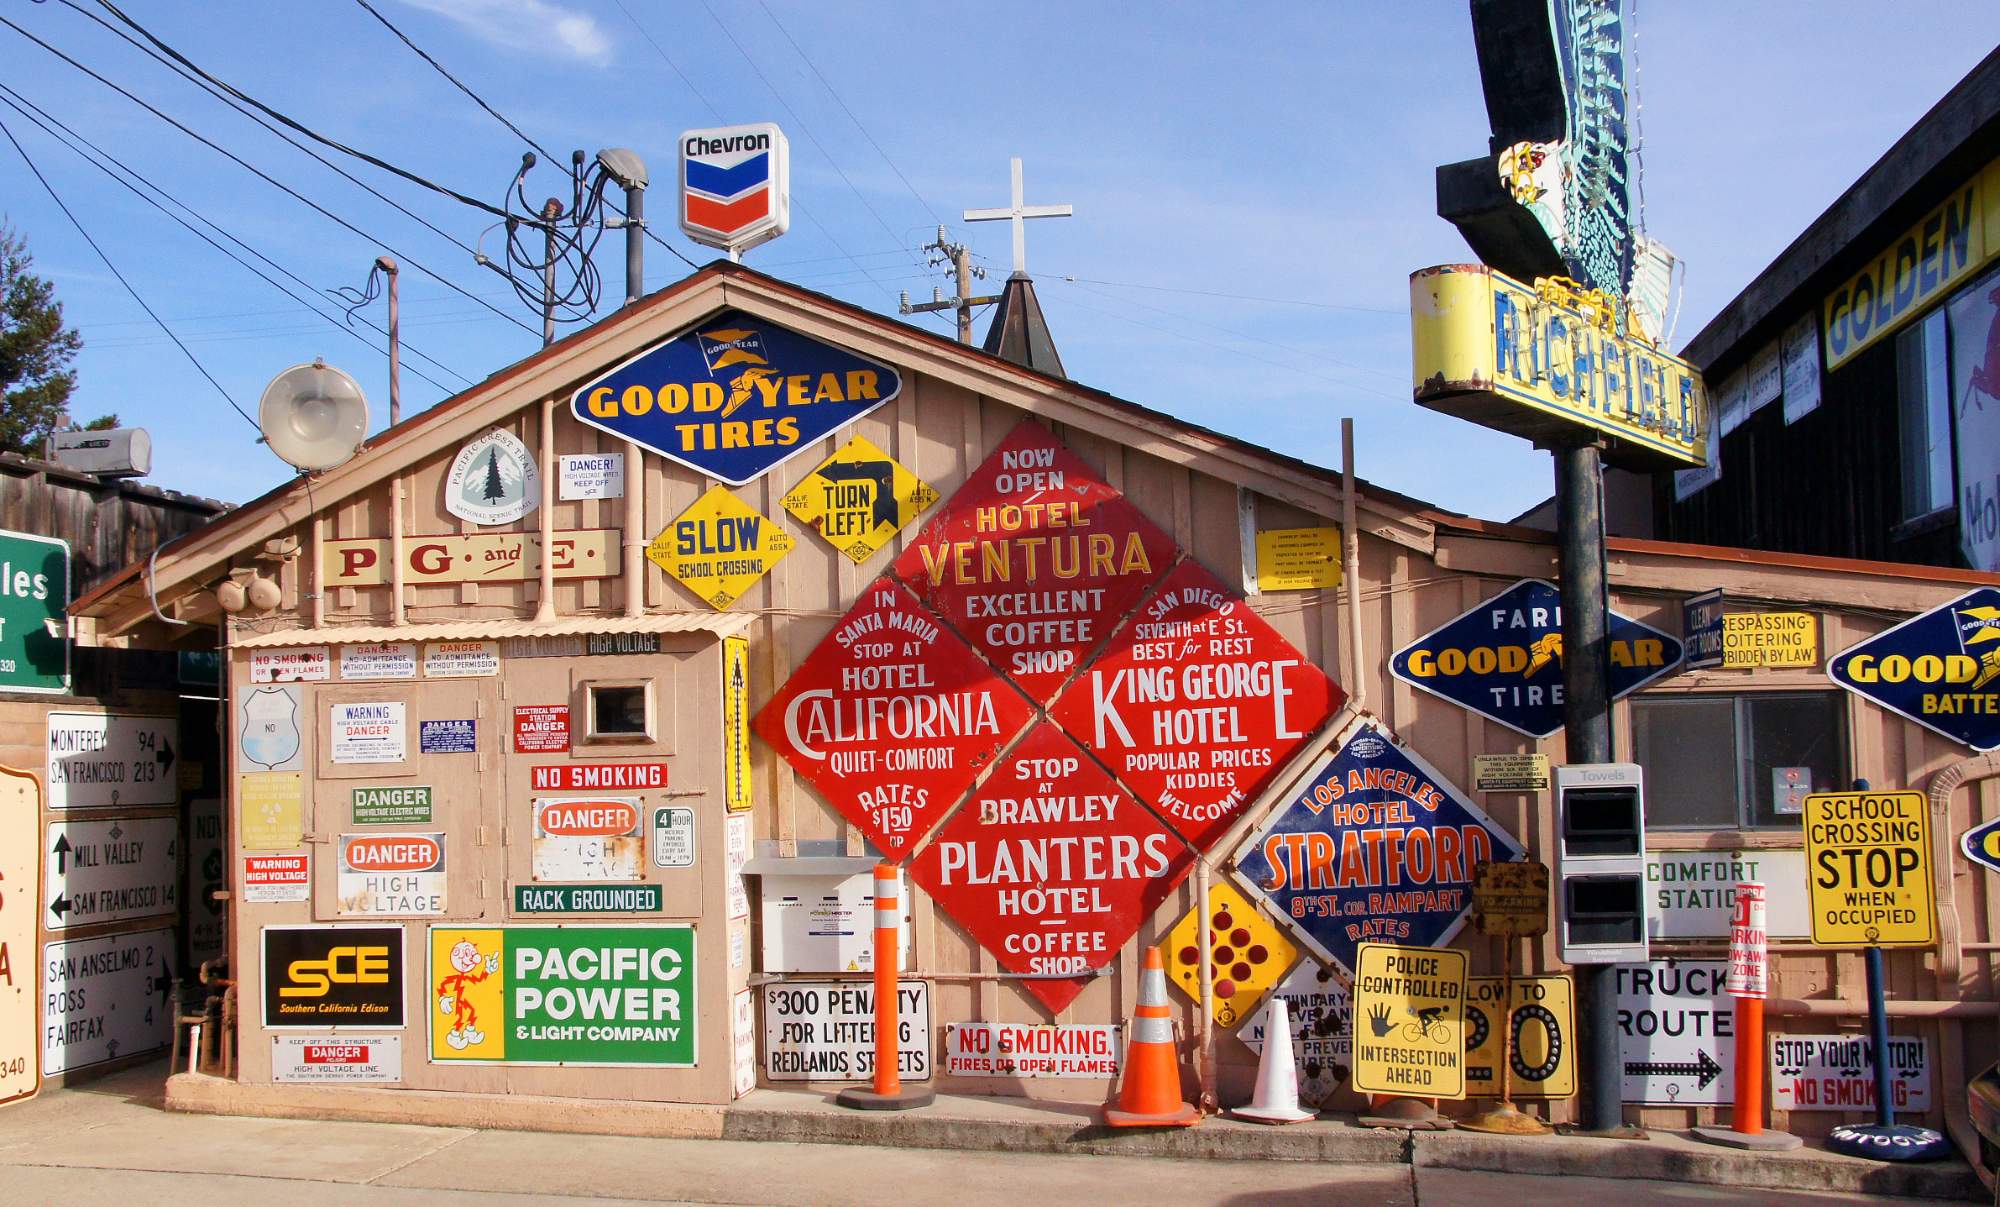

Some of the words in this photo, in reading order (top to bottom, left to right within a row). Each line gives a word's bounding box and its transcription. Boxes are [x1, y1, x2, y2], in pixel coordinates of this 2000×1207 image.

[686, 134, 769, 156] Chevron
[1831, 187, 1973, 356] GOLDEN
[675, 417, 800, 451] TIRES
[453, 443, 478, 485] PACIFIC
[480, 431, 514, 449] CREST
[514, 446, 534, 481] TRAIL
[570, 459, 613, 471] DANGER!
[1003, 448, 1055, 470] NOW
[574, 480, 592, 488] KEEP
[595, 479, 609, 487] OFF
[996, 471, 1064, 493] OPEN
[823, 484, 870, 510] TURN
[455, 503, 487, 518] NATIONAL
[977, 502, 1090, 532] HOTEL
[825, 511, 868, 536] LEFT
[677, 516, 761, 555] SLOW
[769, 534, 788, 542] AUTO
[484, 543, 522, 562] and
[653, 551, 672, 559] STATE
[920, 532, 1152, 586] VENTURA
[678, 561, 714, 578] SCHOOL
[716, 559, 763, 577] CROSSING
[875, 591, 895, 607] IN
[966, 589, 1105, 617] EXCELLENT
[1147, 592, 1180, 621] SAN
[1184, 588, 1234, 617] DIEGO
[836, 614, 884, 648] SANTA
[889, 611, 939, 645] MARIA
[986, 619, 1093, 646] COFFEE
[1136, 621, 1192, 639] SEVENTH
[357, 645, 399, 654] DANGER
[439, 643, 482, 652] DANGER
[590, 634, 612, 653] HIGH
[616, 633, 658, 652] VOLTAGE
[854, 642, 893, 659] STOP
[903, 641, 922, 656] AT
[1133, 642, 1175, 660] BEST
[1177, 639, 1201, 661] for
[1210, 638, 1254, 656] REST
[255, 656, 270, 665] NO
[373, 661, 414, 670] PERMISSION
[454, 660, 497, 668] PERMISSION
[1012, 649, 1074, 675] SHOP
[1770, 650, 1784, 663] BY
[1787, 648, 1812, 662] LAW
[842, 664, 934, 691] HOTEL
[1092, 666, 1175, 749] KING
[1183, 660, 1302, 739] GEORGE
[1490, 684, 1564, 707] TIRE
[346, 706, 390, 719] WARNING
[346, 726, 390, 736] DANGER
[521, 722, 565, 731] DANGER
[784, 689, 1000, 760] CALIFORNIA
[1153, 706, 1248, 746] HOTEL
[51, 730, 107, 753] MONTEREY
[1015, 758, 1079, 780] STOP
[1126, 752, 1200, 772] POPULAR
[1211, 748, 1272, 768] PRICES
[51, 762, 70, 784] SAN
[74, 761, 125, 784] FRANCISCO
[134, 761, 155, 782] 213
[537, 769, 560, 788] NO
[572, 766, 661, 787] SMOKING
[1166, 772, 1235, 790] KIDDIES
[1580, 770, 1626, 783] Towels
[355, 790, 427, 806] DANGER
[857, 784, 929, 812] RATES
[1038, 782, 1053, 794] AT
[1302, 775, 1345, 815] LOS
[1349, 767, 1445, 811] ANGELES
[979, 795, 1120, 825] BRAWLEY
[1157, 785, 1247, 821] WELCOME
[1333, 801, 1415, 826] HOTEL
[1821, 799, 1909, 820] SCHOOL
[547, 809, 630, 829] DANGER
[659, 812, 669, 826] 4
[672, 815, 691, 826] HOUR
[1812, 822, 1920, 844] CROSSING
[75, 845, 99, 868] MILL
[104, 841, 143, 865] VALLEY
[253, 860, 301, 869] WARNING
[353, 844, 432, 864] DANGER
[939, 833, 1169, 886] PLANTERS
[1263, 824, 1492, 892] STRATFORD
[246, 872, 267, 881] HIGH
[268, 871, 307, 881] VOLTAGE
[1647, 861, 1760, 882] COMFORT
[1817, 848, 1919, 889] STOP
[367, 877, 418, 892] HIGH
[74, 893, 97, 916] SAN
[99, 887, 156, 912] FRANCISCO
[161, 884, 175, 906] 14
[522, 890, 564, 911] RACK
[572, 889, 656, 911] GROUNDED
[998, 887, 1112, 916] HOTEL
[1369, 889, 1463, 915] RAMPART
[1658, 888, 1737, 909] STATIO
[1844, 892, 1896, 906] WHEN
[1827, 909, 1916, 925] OCCUPIED
[1345, 918, 1410, 942] RATES
[1731, 929, 1766, 945] ARKIN
[1004, 931, 1107, 953] COFFEE
[49, 957, 76, 983] SAN
[80, 949, 140, 979] ANSELMO
[279, 946, 389, 997] SCE
[515, 947, 683, 983] PACIFIC
[1029, 956, 1087, 975] SHOP
[1386, 956, 1438, 977] POLICE
[1733, 964, 1761, 977] ZONE
[1364, 976, 1459, 999] CONTROLLED
[1520, 984, 1545, 1001] TO
[1616, 968, 1728, 997] TRUCK
[49, 988, 86, 1017] ROSS
[279, 1003, 317, 1014] Southern
[319, 1003, 358, 1014] California
[361, 1003, 389, 1014] Edison
[515, 988, 681, 1022] POWER
[769, 990, 819, 1016] $300
[828, 989, 922, 1016] PENTY
[47, 1015, 105, 1050] FAIRFAX
[516, 1025, 529, 1040] &
[531, 1026, 585, 1042] LIGHT
[587, 1026, 681, 1042] COMPANY
[783, 1022, 815, 1044] FOR
[1617, 1010, 1734, 1038] ROUTE
[311, 1046, 361, 1058] DANGER
[960, 1028, 990, 1054] NO
[772, 1051, 849, 1073] REDLANDS
[1361, 1045, 1457, 1068] INTERSECTION
[1775, 1041, 1814, 1068] STOP
[1819, 1040, 1860, 1069] YOUR
[1863, 1041, 1924, 1069] MTOR!
[359, 1065, 380, 1073] LINE
[951, 1058, 991, 1071] FIRES
[1020, 1059, 1057, 1072] OPEN
[1061, 1060, 1119, 1074] FLAMES
[1386, 1067, 1432, 1086] AHEAD
[1794, 1079, 1818, 1106] NO
